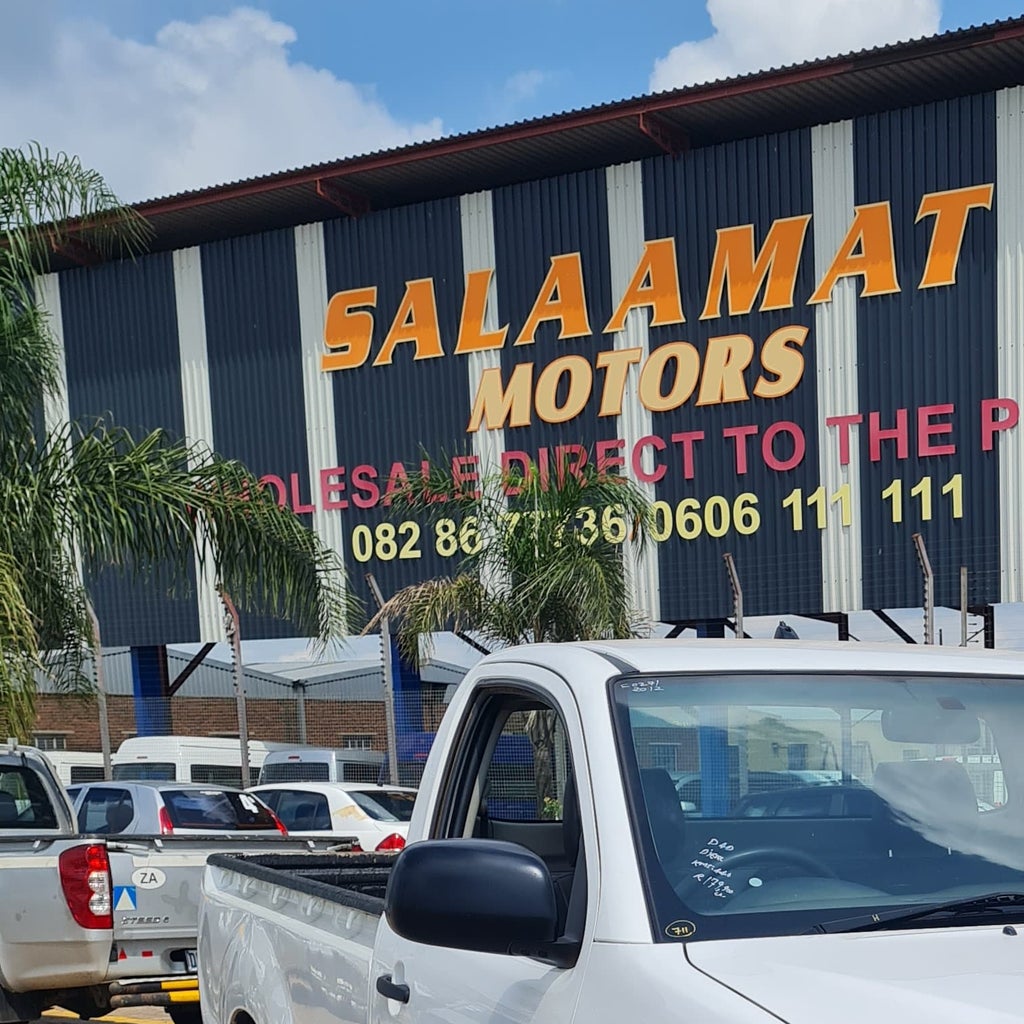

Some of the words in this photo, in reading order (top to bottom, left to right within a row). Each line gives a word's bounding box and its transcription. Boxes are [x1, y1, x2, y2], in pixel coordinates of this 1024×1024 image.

[321, 183, 994, 372] SALAAMAT
[467, 325, 809, 432] MOTORS
[187, 461, 481, 521] OLESALE
[501, 430, 705, 497] DIRECT
[724, 421, 806, 475] TO
[826, 403, 956, 465] THE
[352, 520, 421, 563] 082
[651, 492, 760, 543] 0606
[783, 484, 852, 531] 111
[882, 473, 964, 523] 111
[140, 872, 158, 884] ZA
